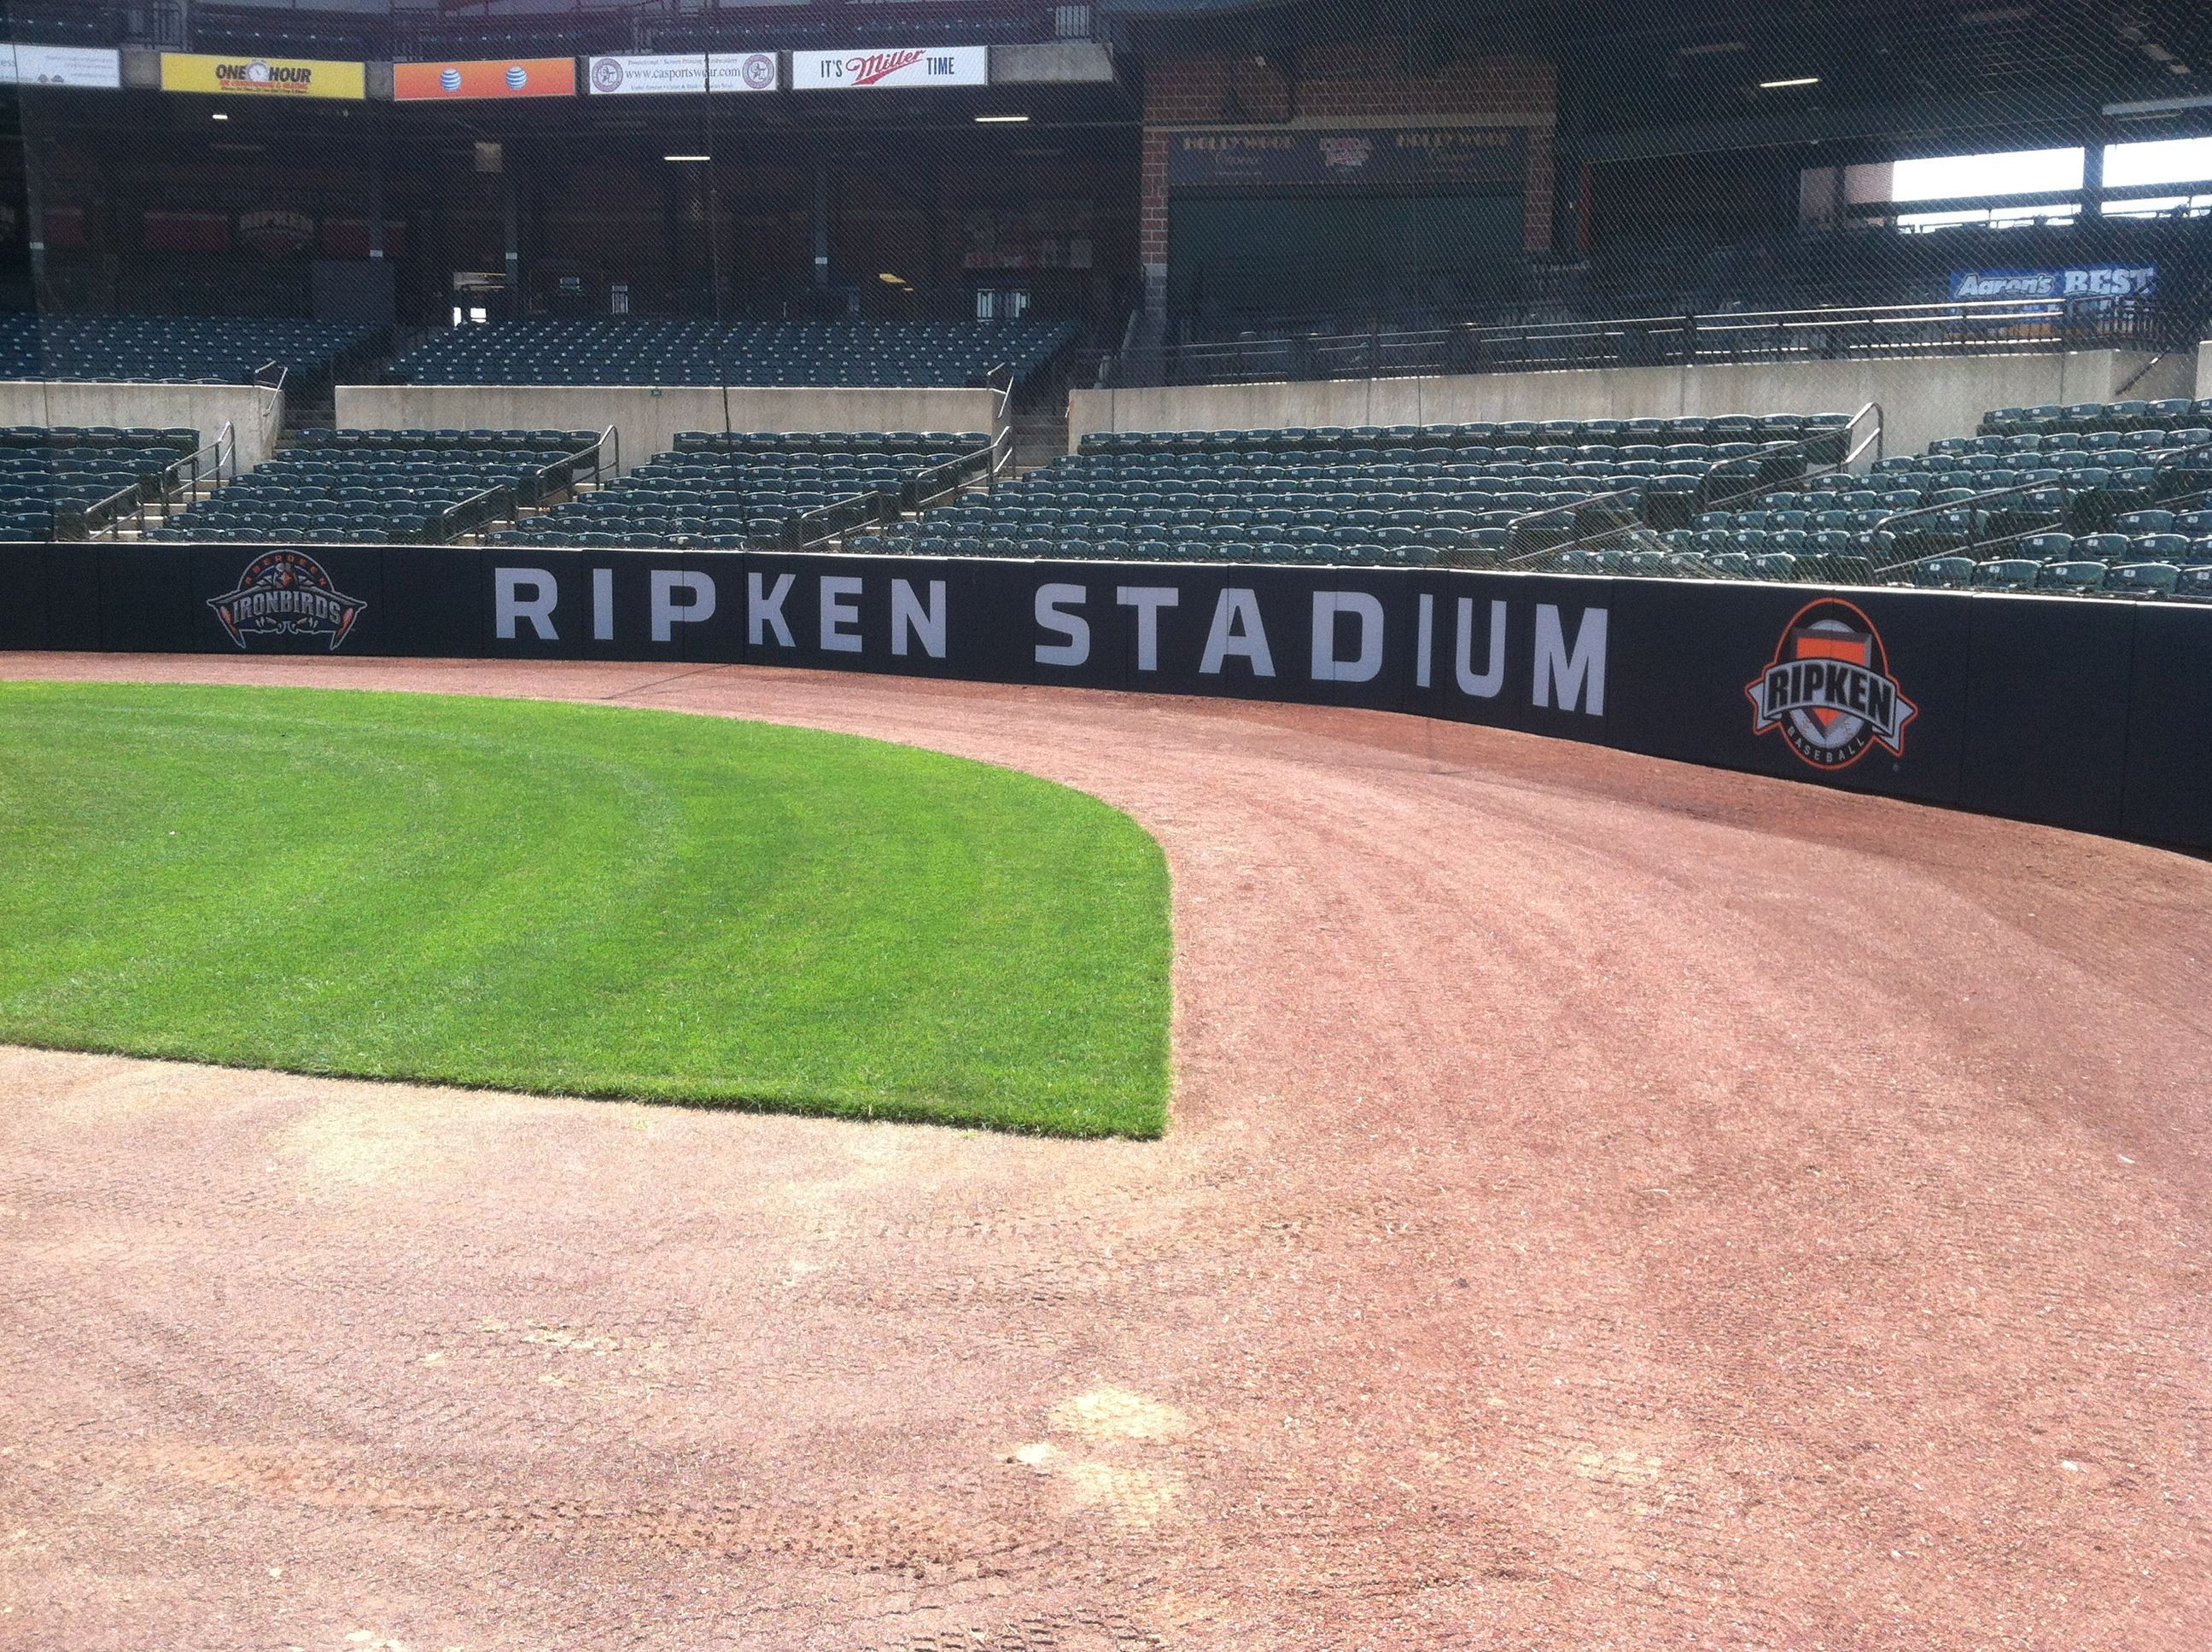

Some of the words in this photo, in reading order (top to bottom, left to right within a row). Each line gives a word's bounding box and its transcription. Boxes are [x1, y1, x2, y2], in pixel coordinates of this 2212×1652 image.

[215, 63, 247, 80] ONE
[268, 67, 312, 83] HOUR
[820, 60, 843, 78] IT'S
[846, 50, 926, 82] Miller
[926, 57, 954, 75] TIME
[1956, 272, 2054, 297] Aaron's
[2063, 266, 2154, 295] BEST
[232, 590, 342, 625] IRONBIRDS
[494, 567, 947, 658] RIPKEN
[1033, 582, 1608, 716] STADIUM
[1766, 663, 1894, 733] RIPKEN
[1787, 726, 1865, 763] BASEBALL
